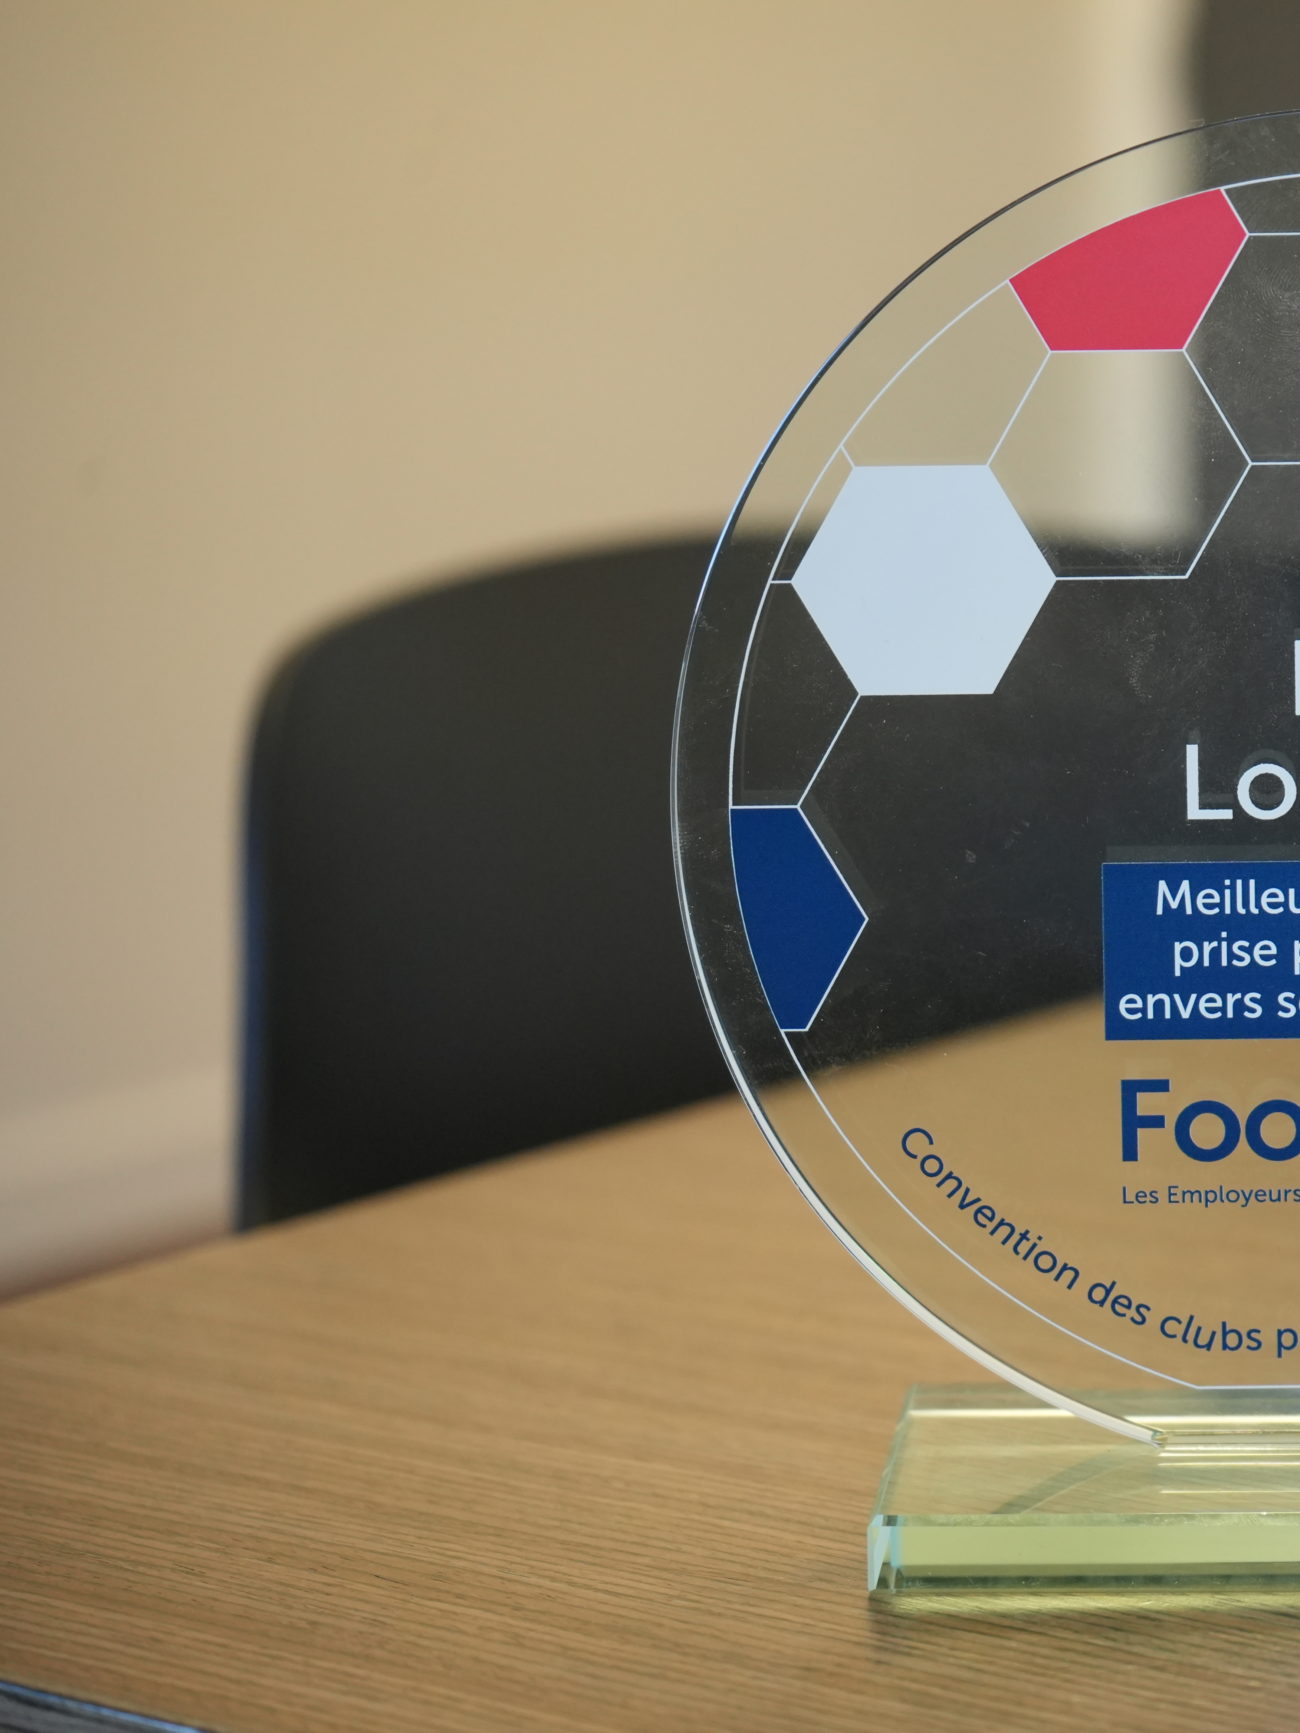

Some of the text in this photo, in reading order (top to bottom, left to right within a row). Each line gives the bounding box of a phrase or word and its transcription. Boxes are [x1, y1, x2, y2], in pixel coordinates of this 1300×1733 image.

[1172, 931, 1278, 977] prise
[1117, 990, 1263, 1021] envers
[1121, 1184, 1159, 1205] Les
[901, 1127, 1081, 1291] Convention
[1087, 1280, 1152, 1327] des
[1159, 1314, 1263, 1352] clubs
